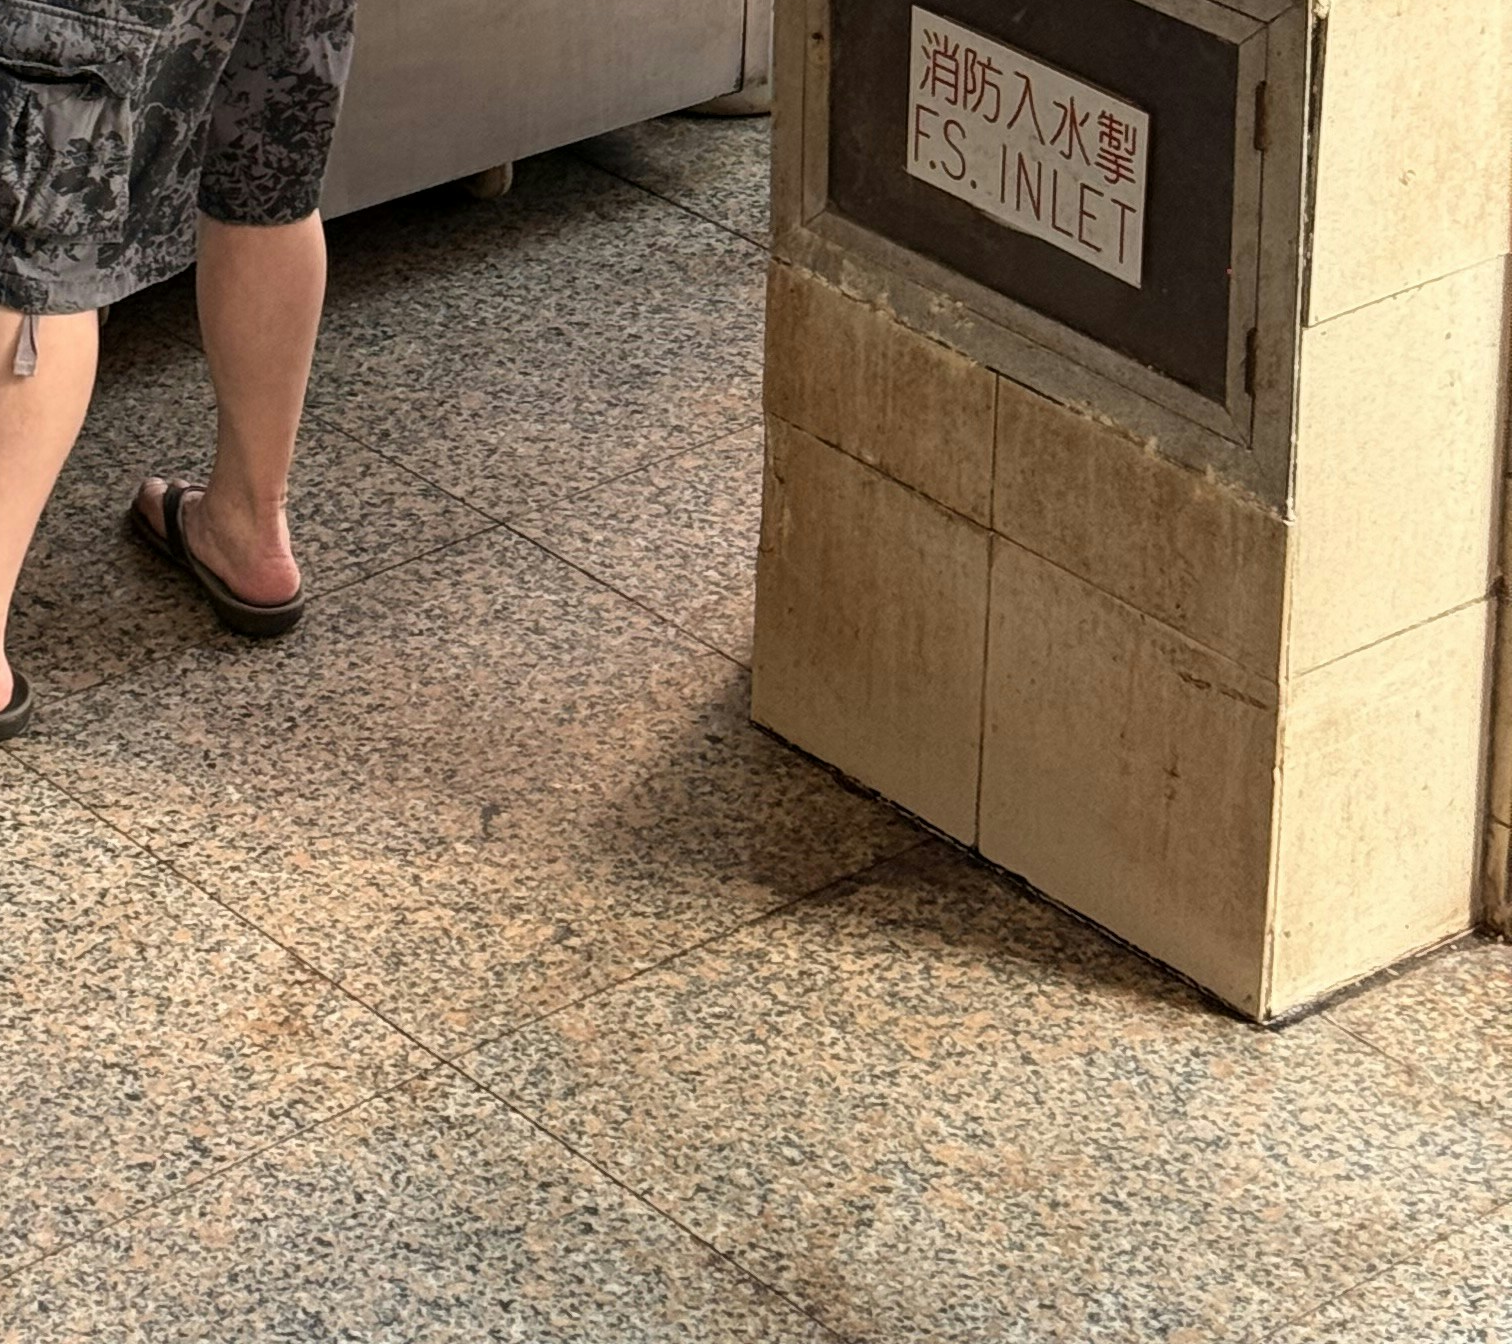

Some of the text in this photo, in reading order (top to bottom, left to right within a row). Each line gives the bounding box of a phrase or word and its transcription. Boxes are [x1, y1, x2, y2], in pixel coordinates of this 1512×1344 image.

[914, 104, 1137, 263] F.S. INLET
[920, 29, 1137, 185] 消防入水掣
